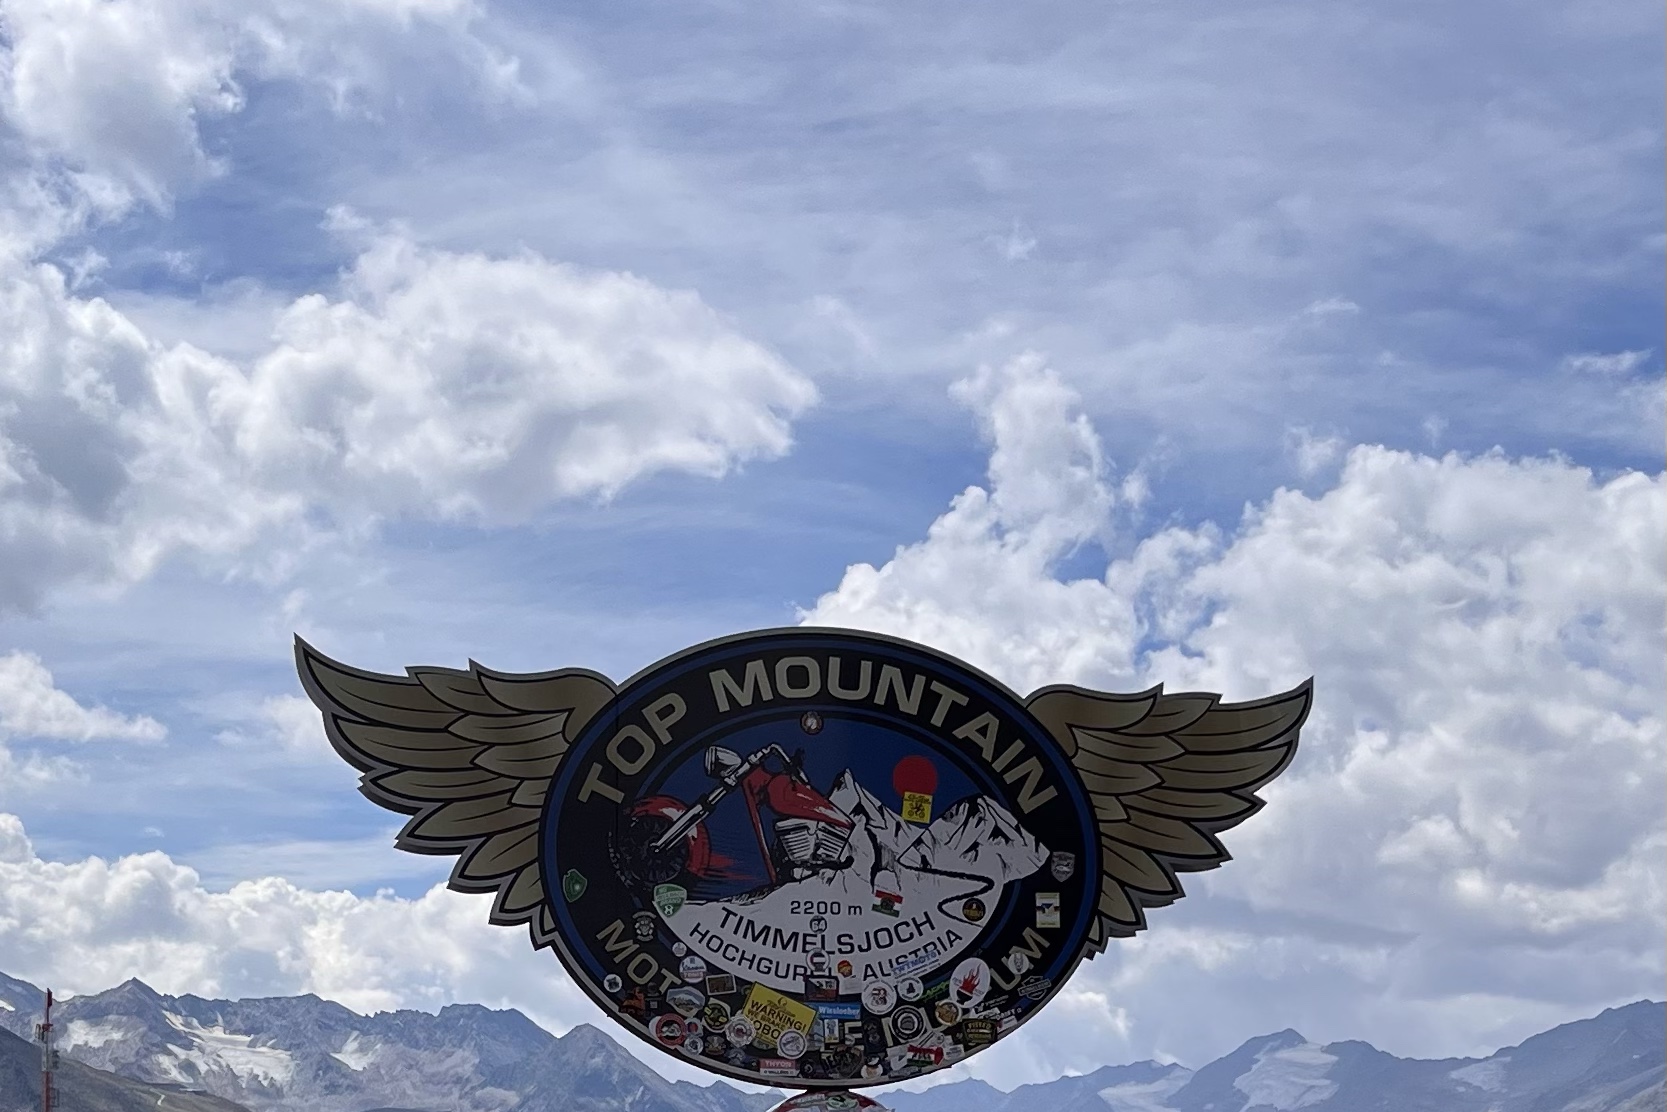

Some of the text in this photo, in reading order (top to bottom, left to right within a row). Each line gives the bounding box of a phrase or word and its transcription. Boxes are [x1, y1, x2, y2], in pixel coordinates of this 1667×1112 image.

[577, 655, 1058, 815] TOP MOUNTAIN
[720, 906, 935, 955] TIMMELSJOCH
[790, 900, 863, 915] 2200 m
[689, 922, 832, 982] HOCHGUR
[750, 1000, 807, 1032] WARNING!
